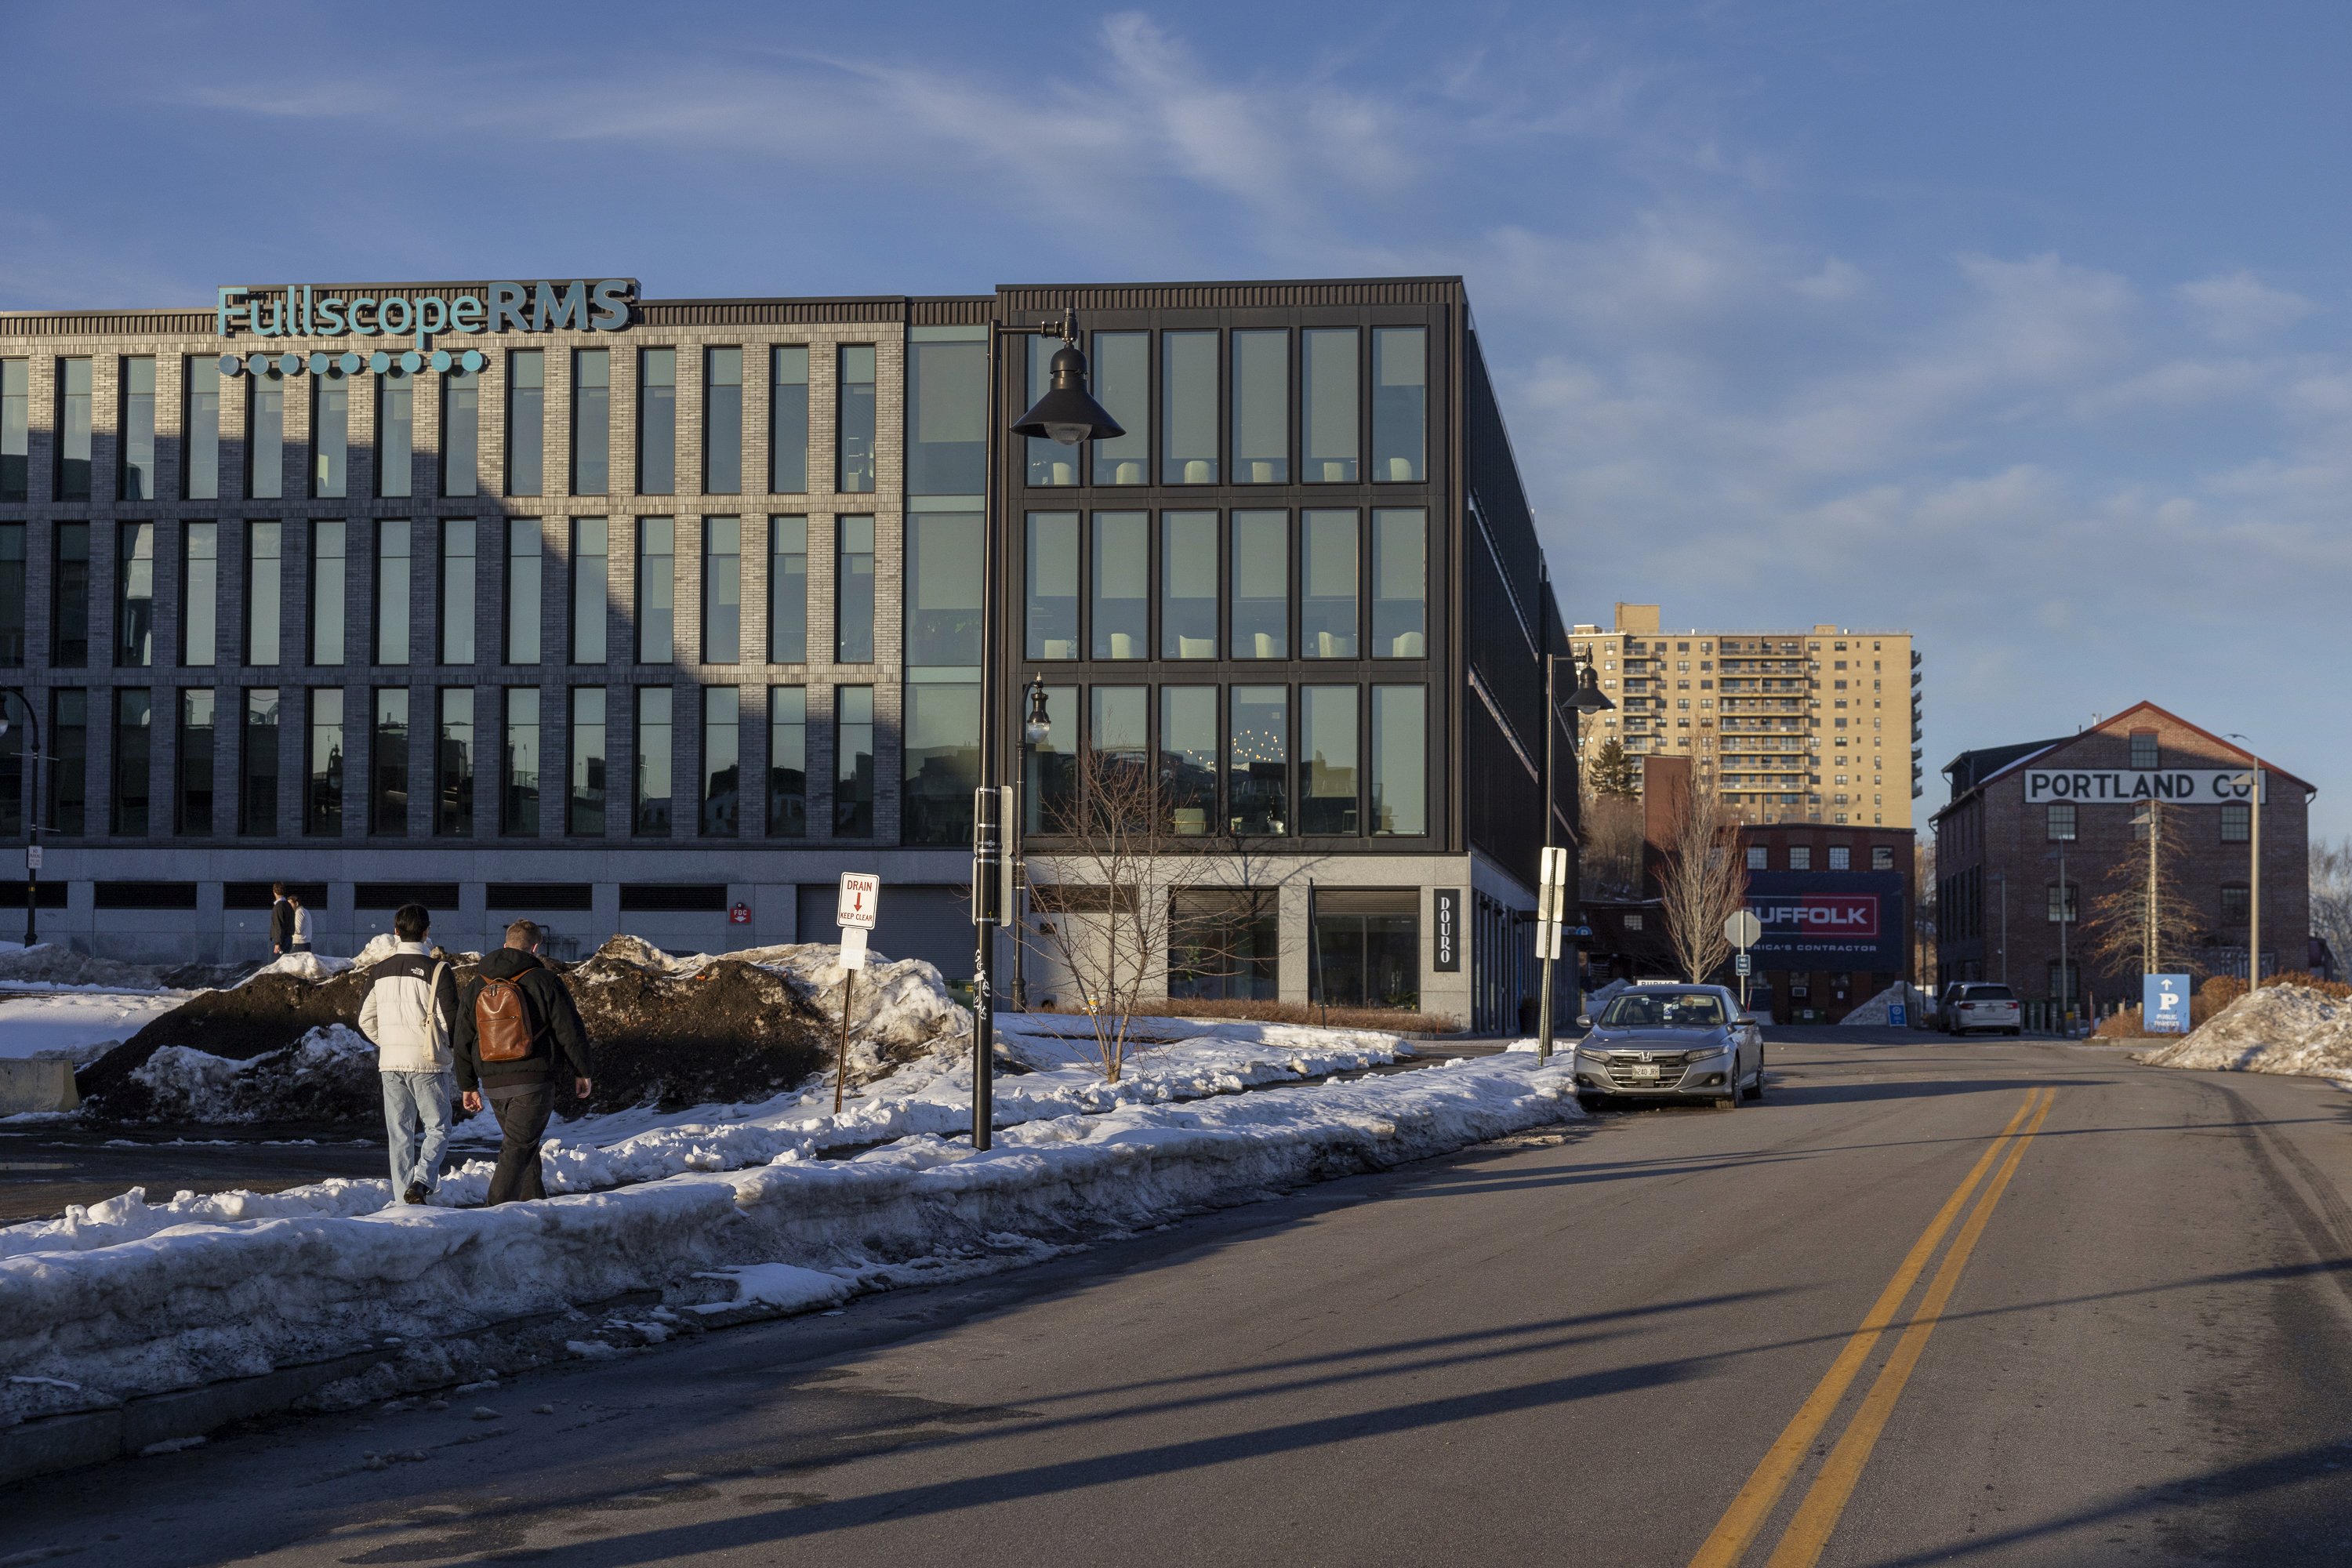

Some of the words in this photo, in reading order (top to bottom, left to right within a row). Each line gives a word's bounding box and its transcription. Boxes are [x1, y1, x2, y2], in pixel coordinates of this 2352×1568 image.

[2031, 773, 2194, 799] PORTLAND
[847, 880, 873, 892] DRAIN
[1743, 906, 1867, 924] UFFOLK
[1440, 897, 1450, 963] DOURO
[2158, 993, 2180, 1011] P
